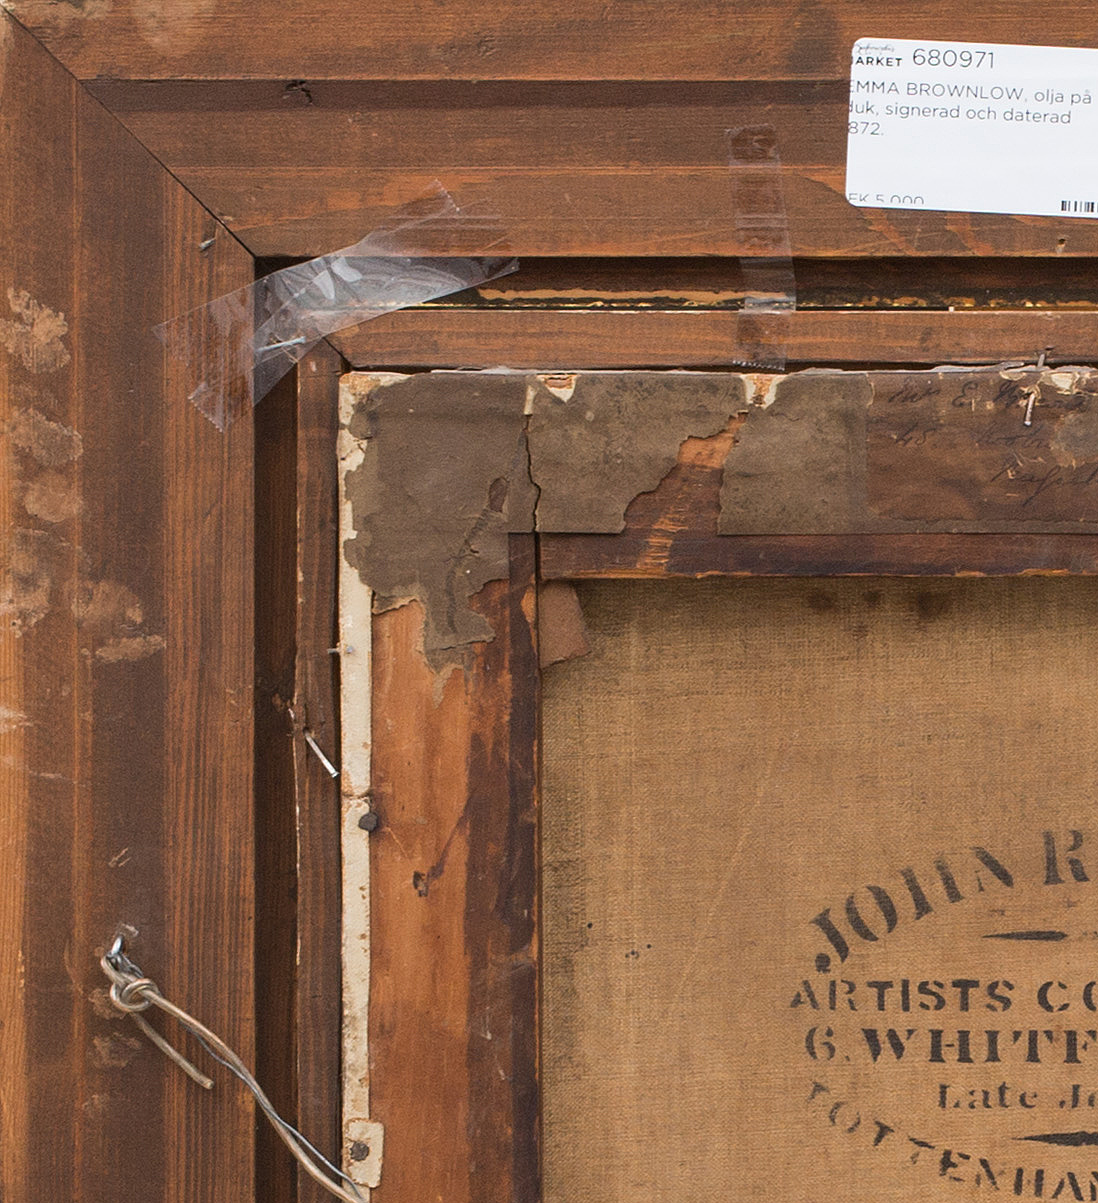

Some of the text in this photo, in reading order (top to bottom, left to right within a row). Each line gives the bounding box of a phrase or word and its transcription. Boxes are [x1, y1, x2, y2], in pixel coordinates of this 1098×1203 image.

[851, 56, 902, 67] ARKET
[912, 48, 995, 69] 680971
[906, 82, 1027, 102] BROWNLOW,
[1034, 89, 1064, 105] olja
[1071, 88, 1093, 106] på
[884, 102, 960, 119] signerad
[965, 107, 997, 121] och
[1003, 109, 1072, 125] daterad
[809, 845, 1014, 974] JOHN
[789, 979, 1014, 1013] ARTISTS
[938, 1082, 1038, 1109] Late
